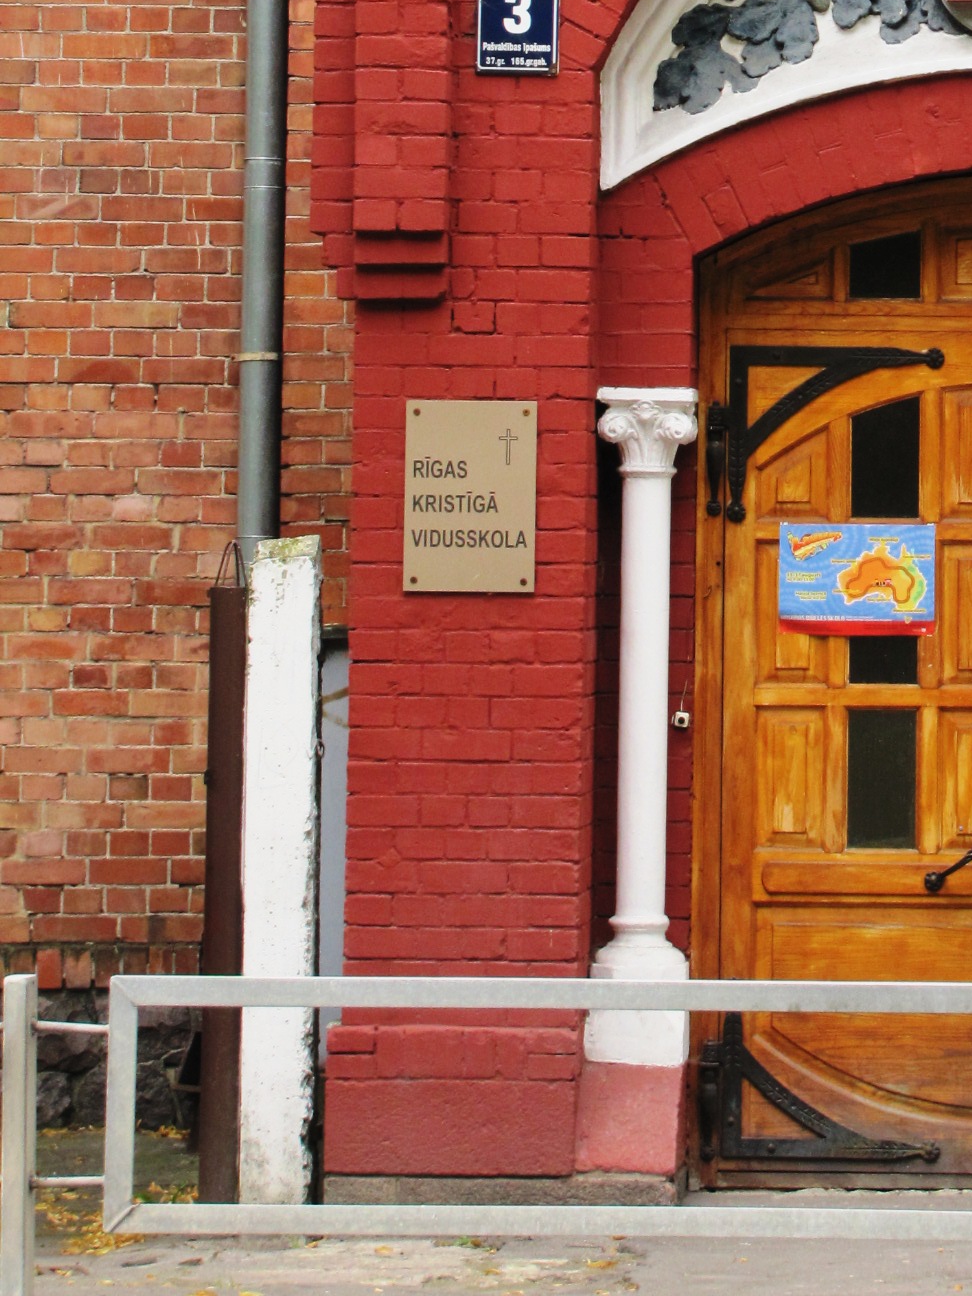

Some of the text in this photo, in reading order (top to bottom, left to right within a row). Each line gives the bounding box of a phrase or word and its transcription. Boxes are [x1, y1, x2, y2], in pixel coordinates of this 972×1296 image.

[412, 456, 468, 479] RĪGAS
[412, 491, 499, 513] KRISTĪGĀ
[411, 529, 528, 548] VIDUSSKOLA
